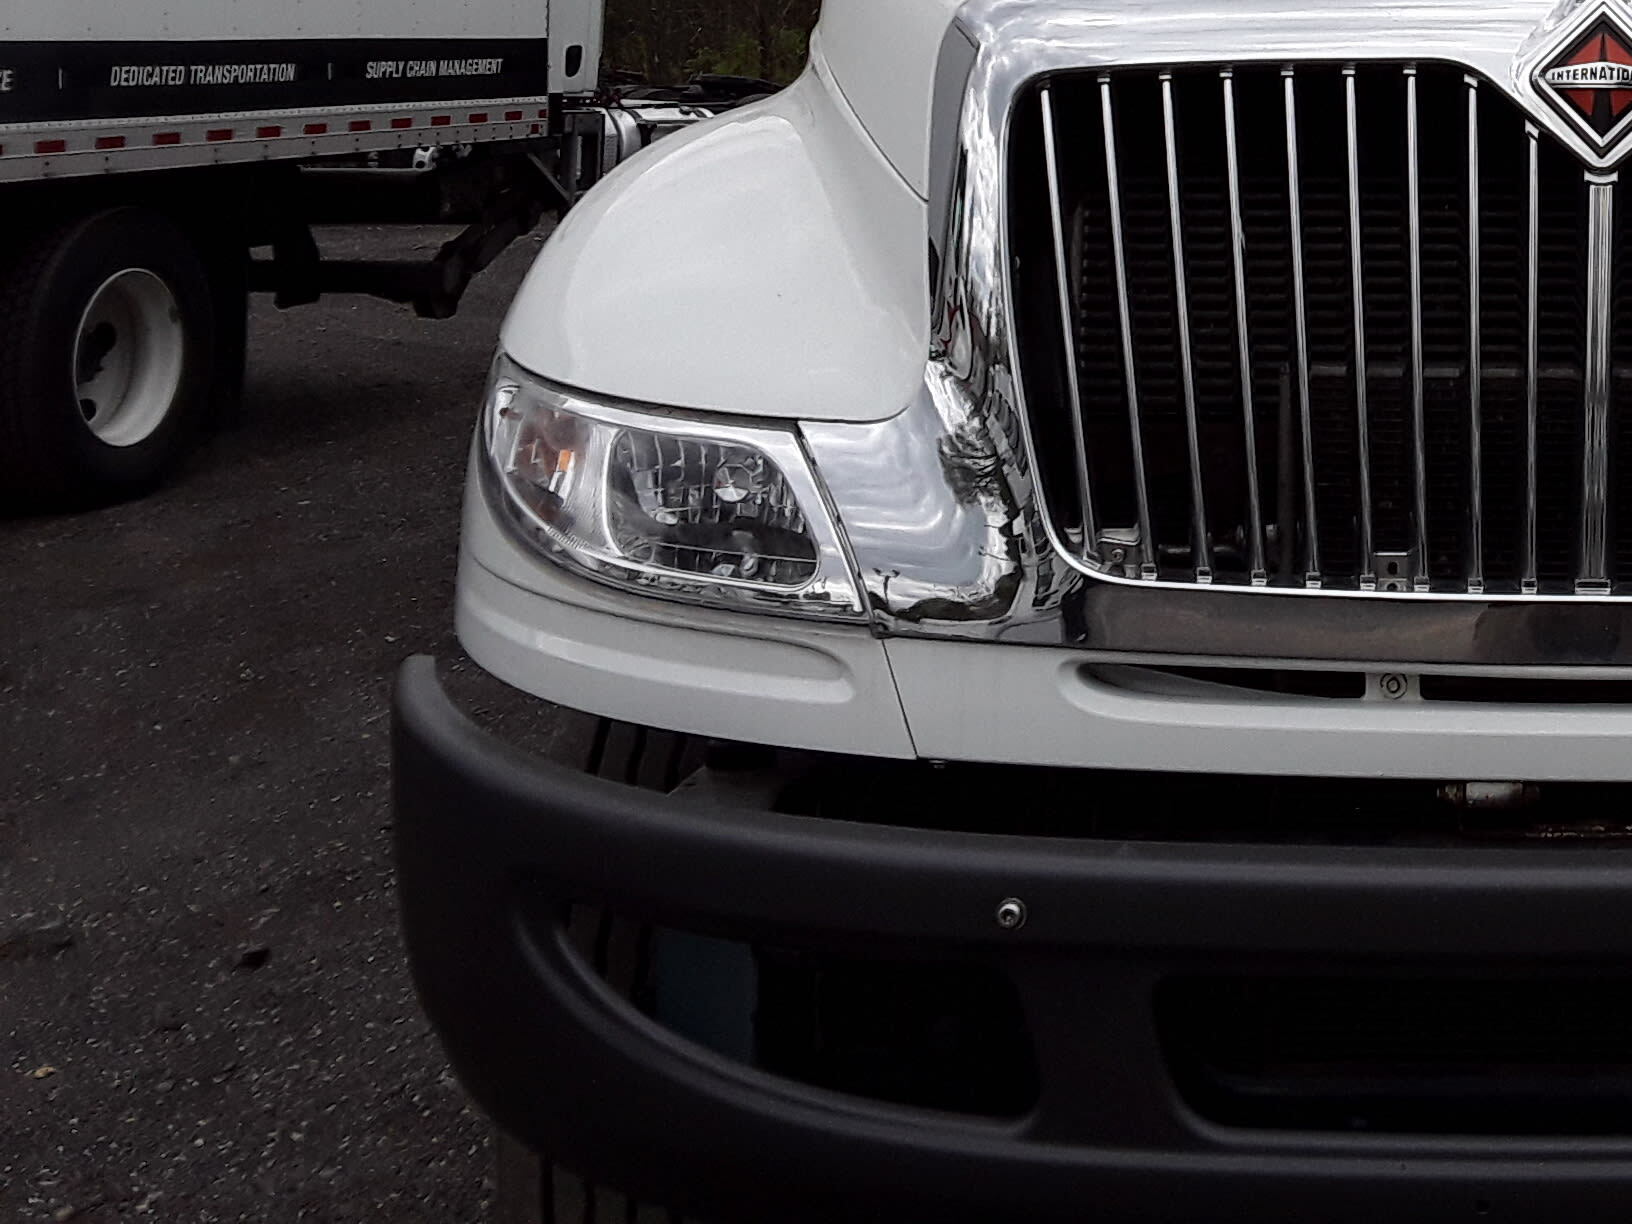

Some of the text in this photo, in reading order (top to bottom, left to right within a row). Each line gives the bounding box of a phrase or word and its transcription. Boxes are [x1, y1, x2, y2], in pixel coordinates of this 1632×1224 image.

[110, 64, 297, 87] DEDICATED TRANSPORTATION
[366, 58, 504, 79] SUPPLY CHAIN MANAGEMENT
